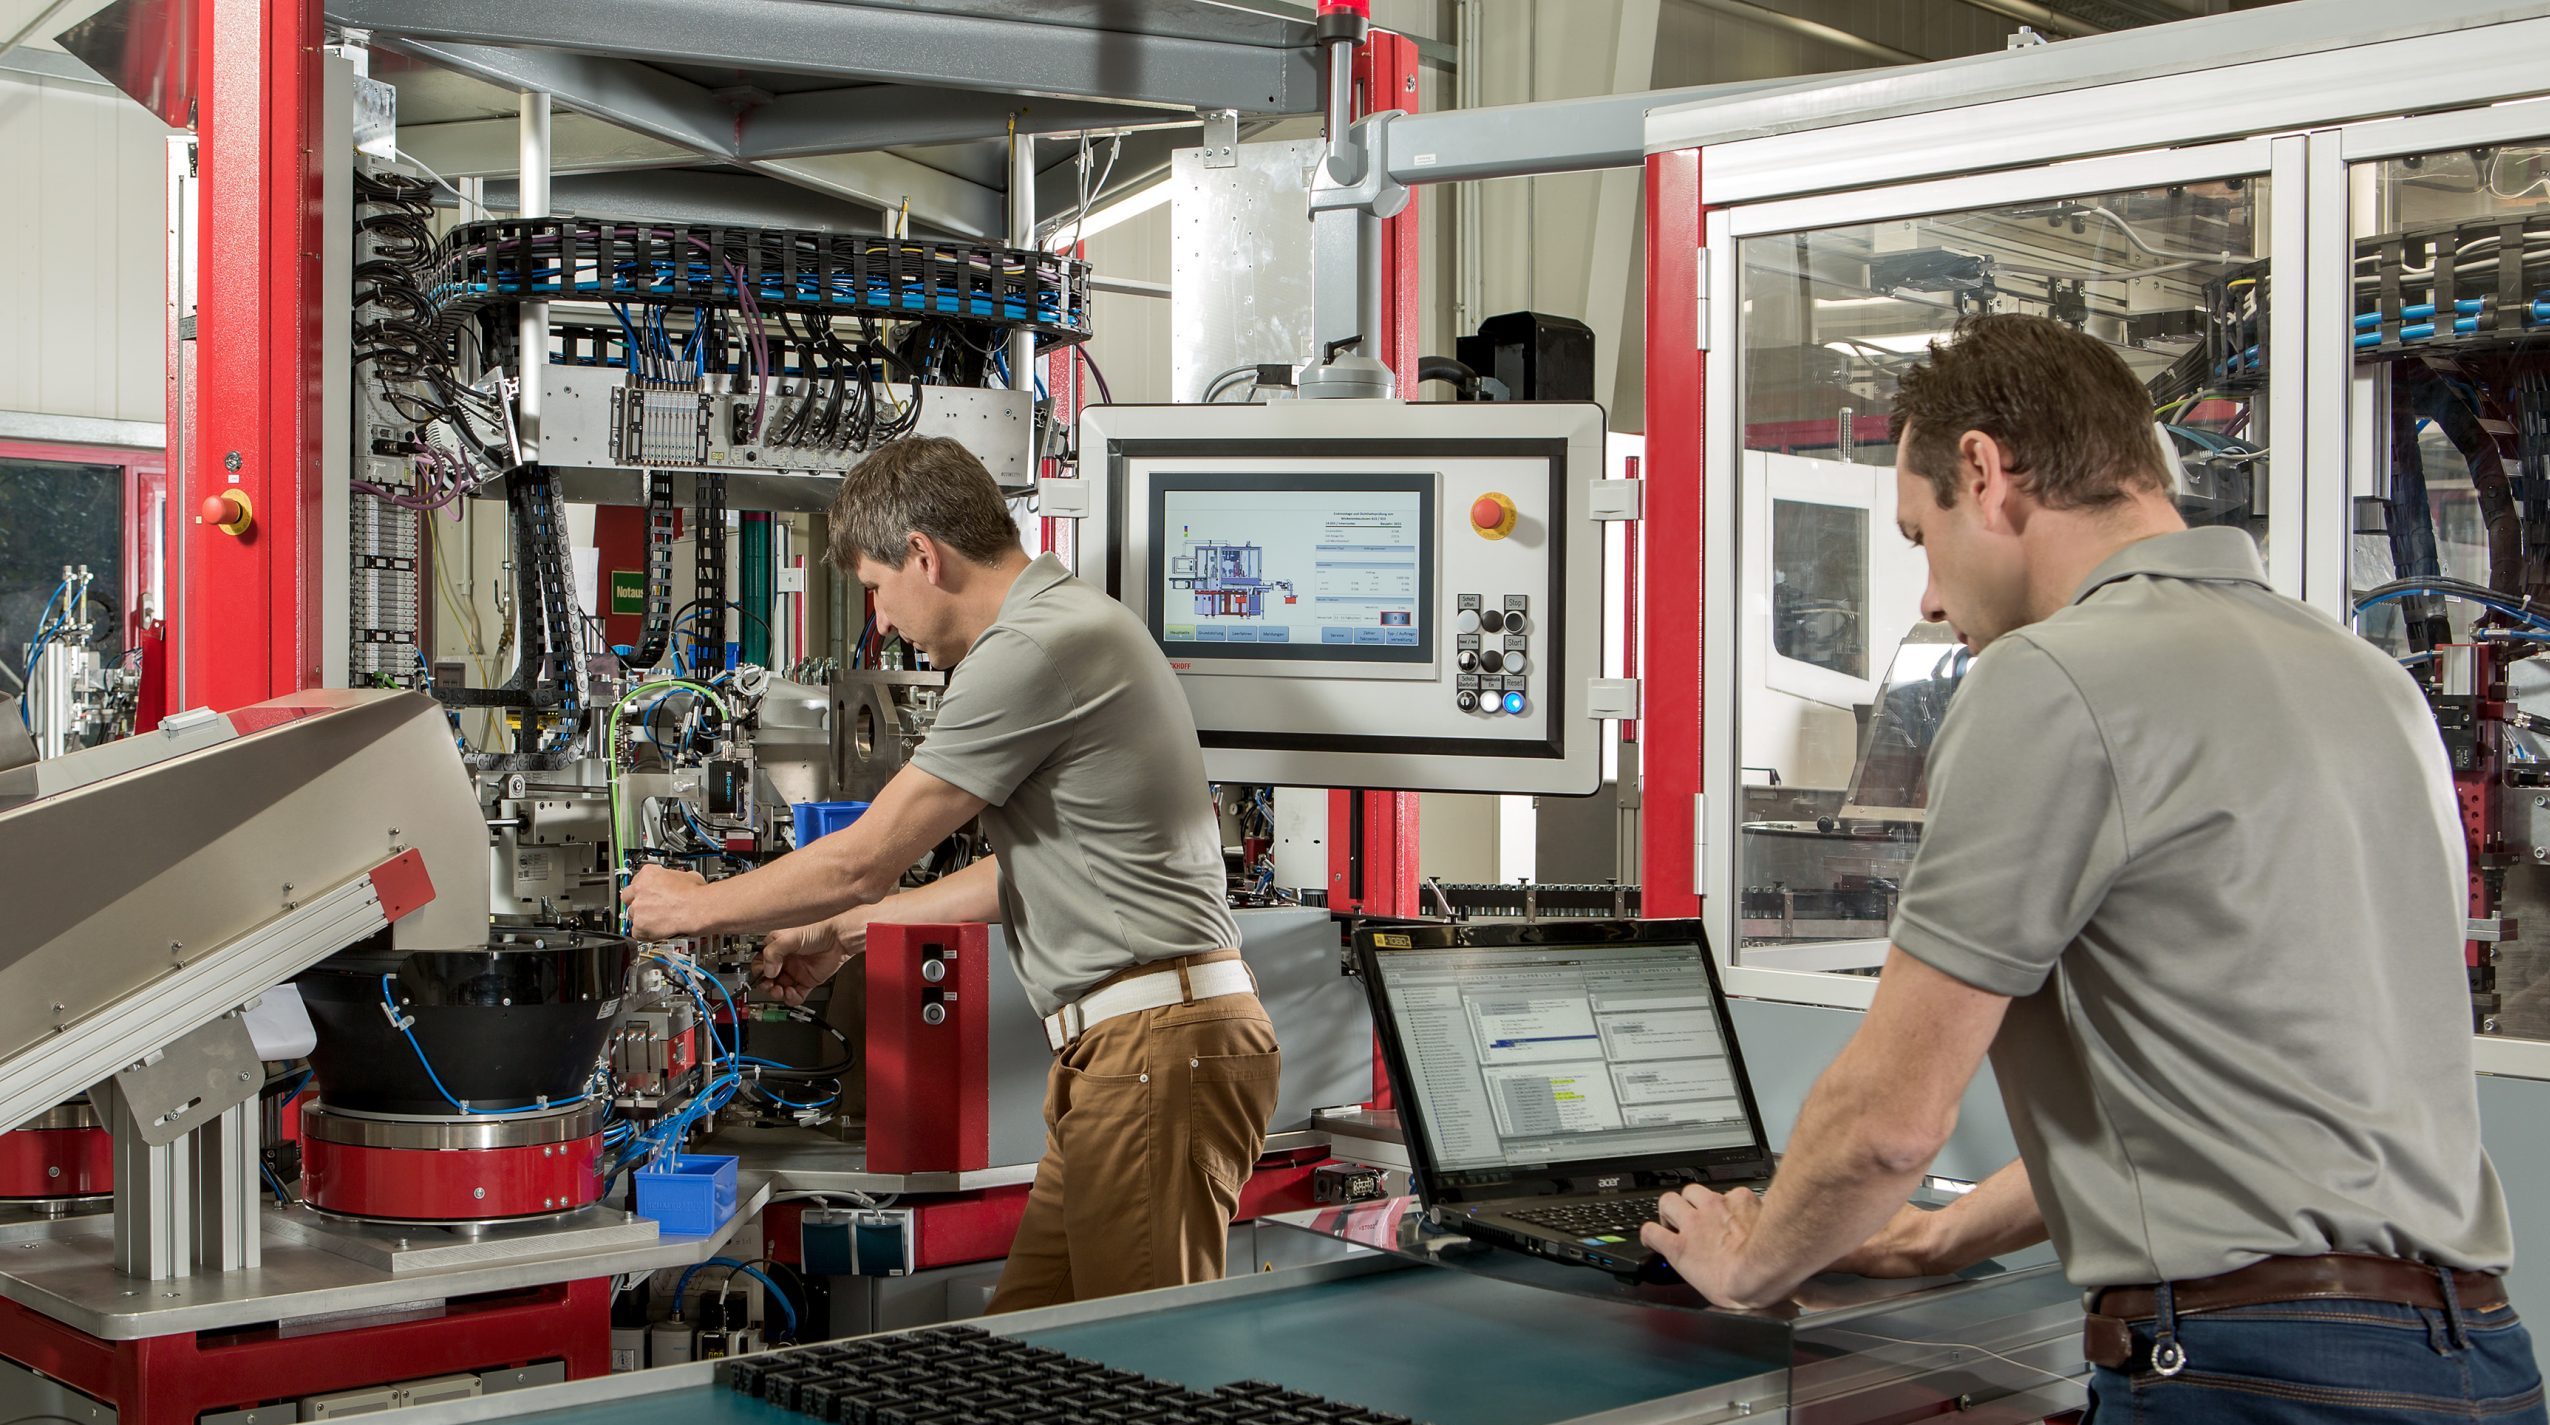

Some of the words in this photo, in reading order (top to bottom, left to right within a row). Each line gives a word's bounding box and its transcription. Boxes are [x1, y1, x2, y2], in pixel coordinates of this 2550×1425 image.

[616, 585, 644, 598] Notaus
[1508, 598, 1522, 607] Stop
[1508, 639, 1522, 647] Start
[1170, 662, 1191, 670] KHOFF
[1598, 1177, 1620, 1187] acer
